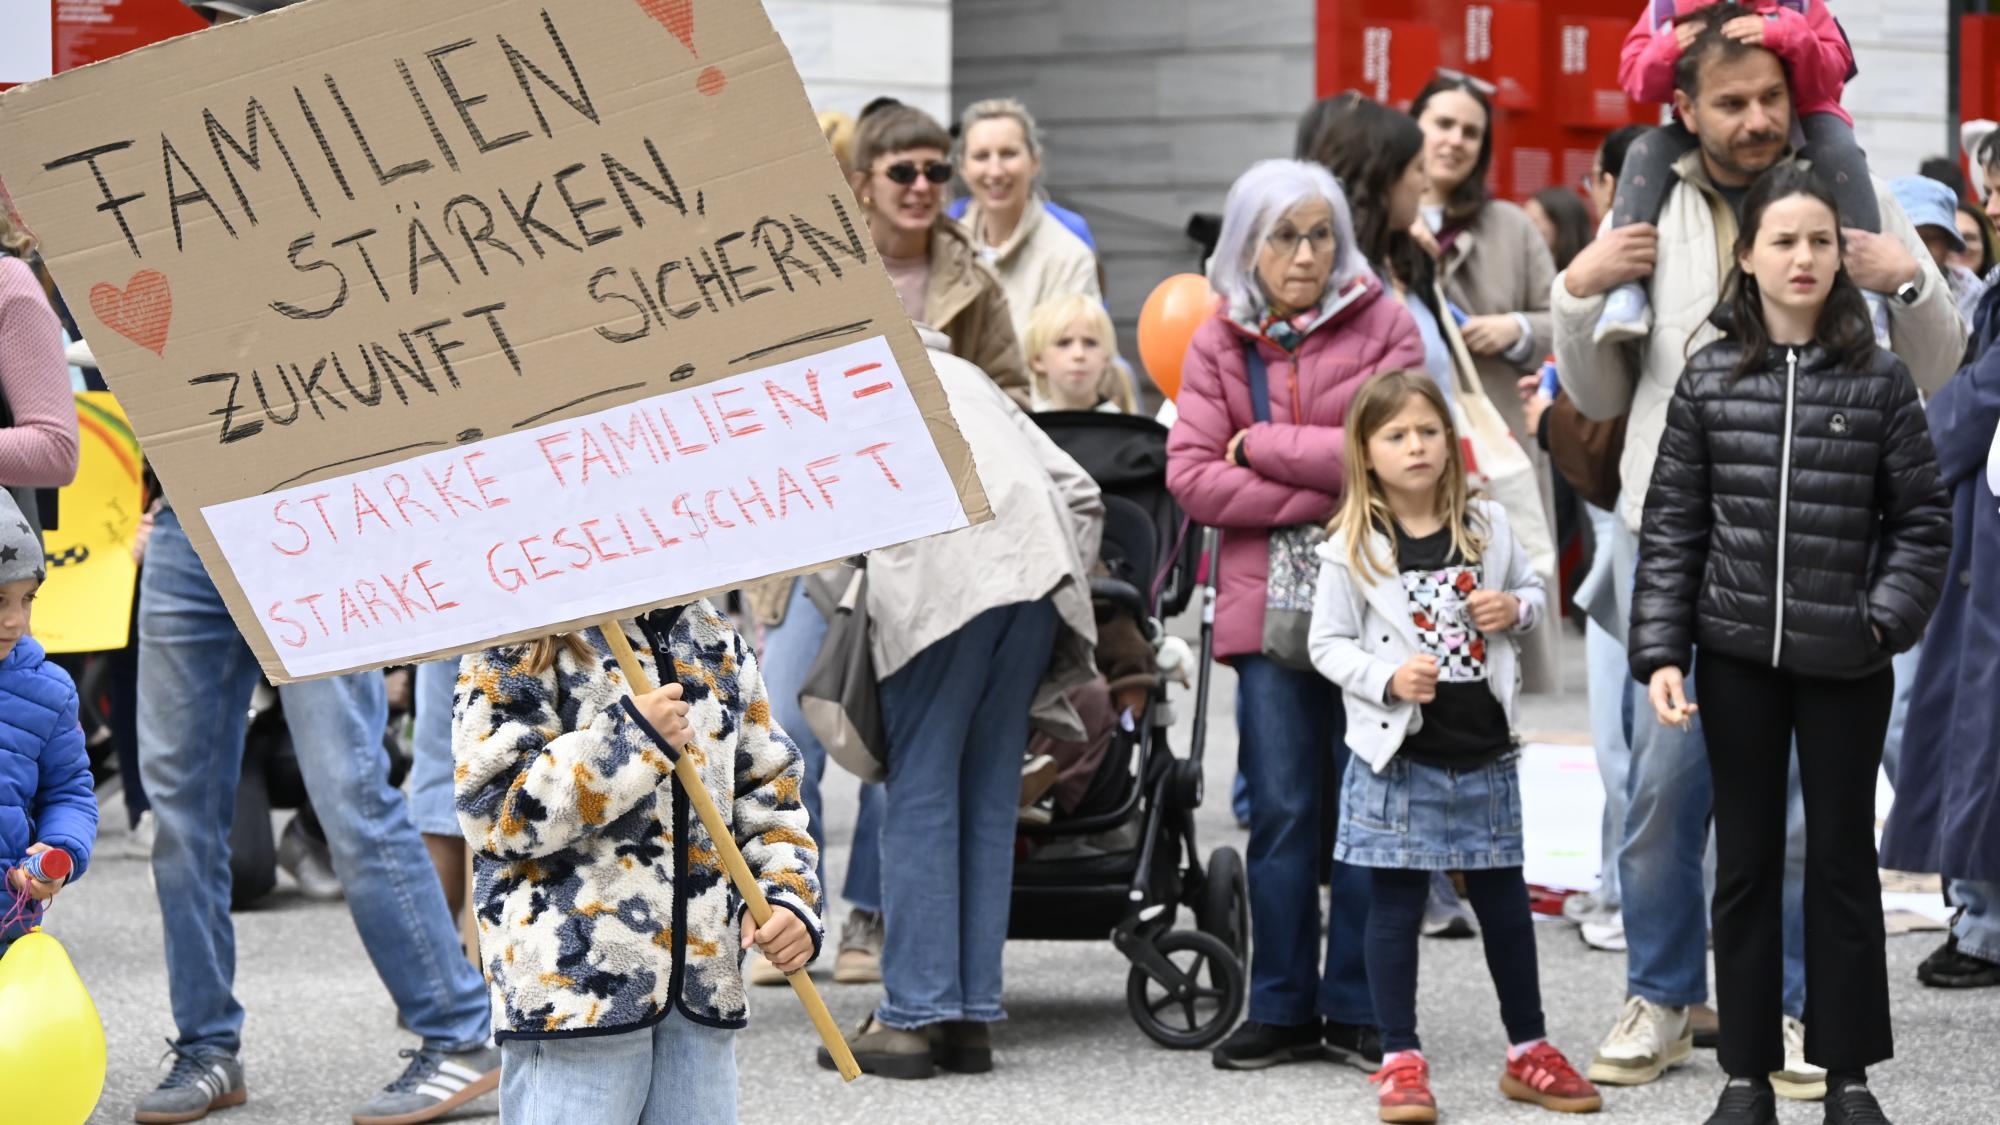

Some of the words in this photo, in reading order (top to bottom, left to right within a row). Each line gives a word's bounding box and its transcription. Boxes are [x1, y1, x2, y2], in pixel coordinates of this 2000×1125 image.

[42, 7, 600, 258] FAMILIEN
[268, 136, 705, 320] STÄRKEN,
[188, 303, 522, 443] ZUKUNFT
[587, 193, 868, 343] SICHERN
[271, 451, 511, 556] STARKE
[536, 368, 829, 488] FAMILIEN
[843, 361, 893, 398] =
[268, 559, 460, 647] STARKE
